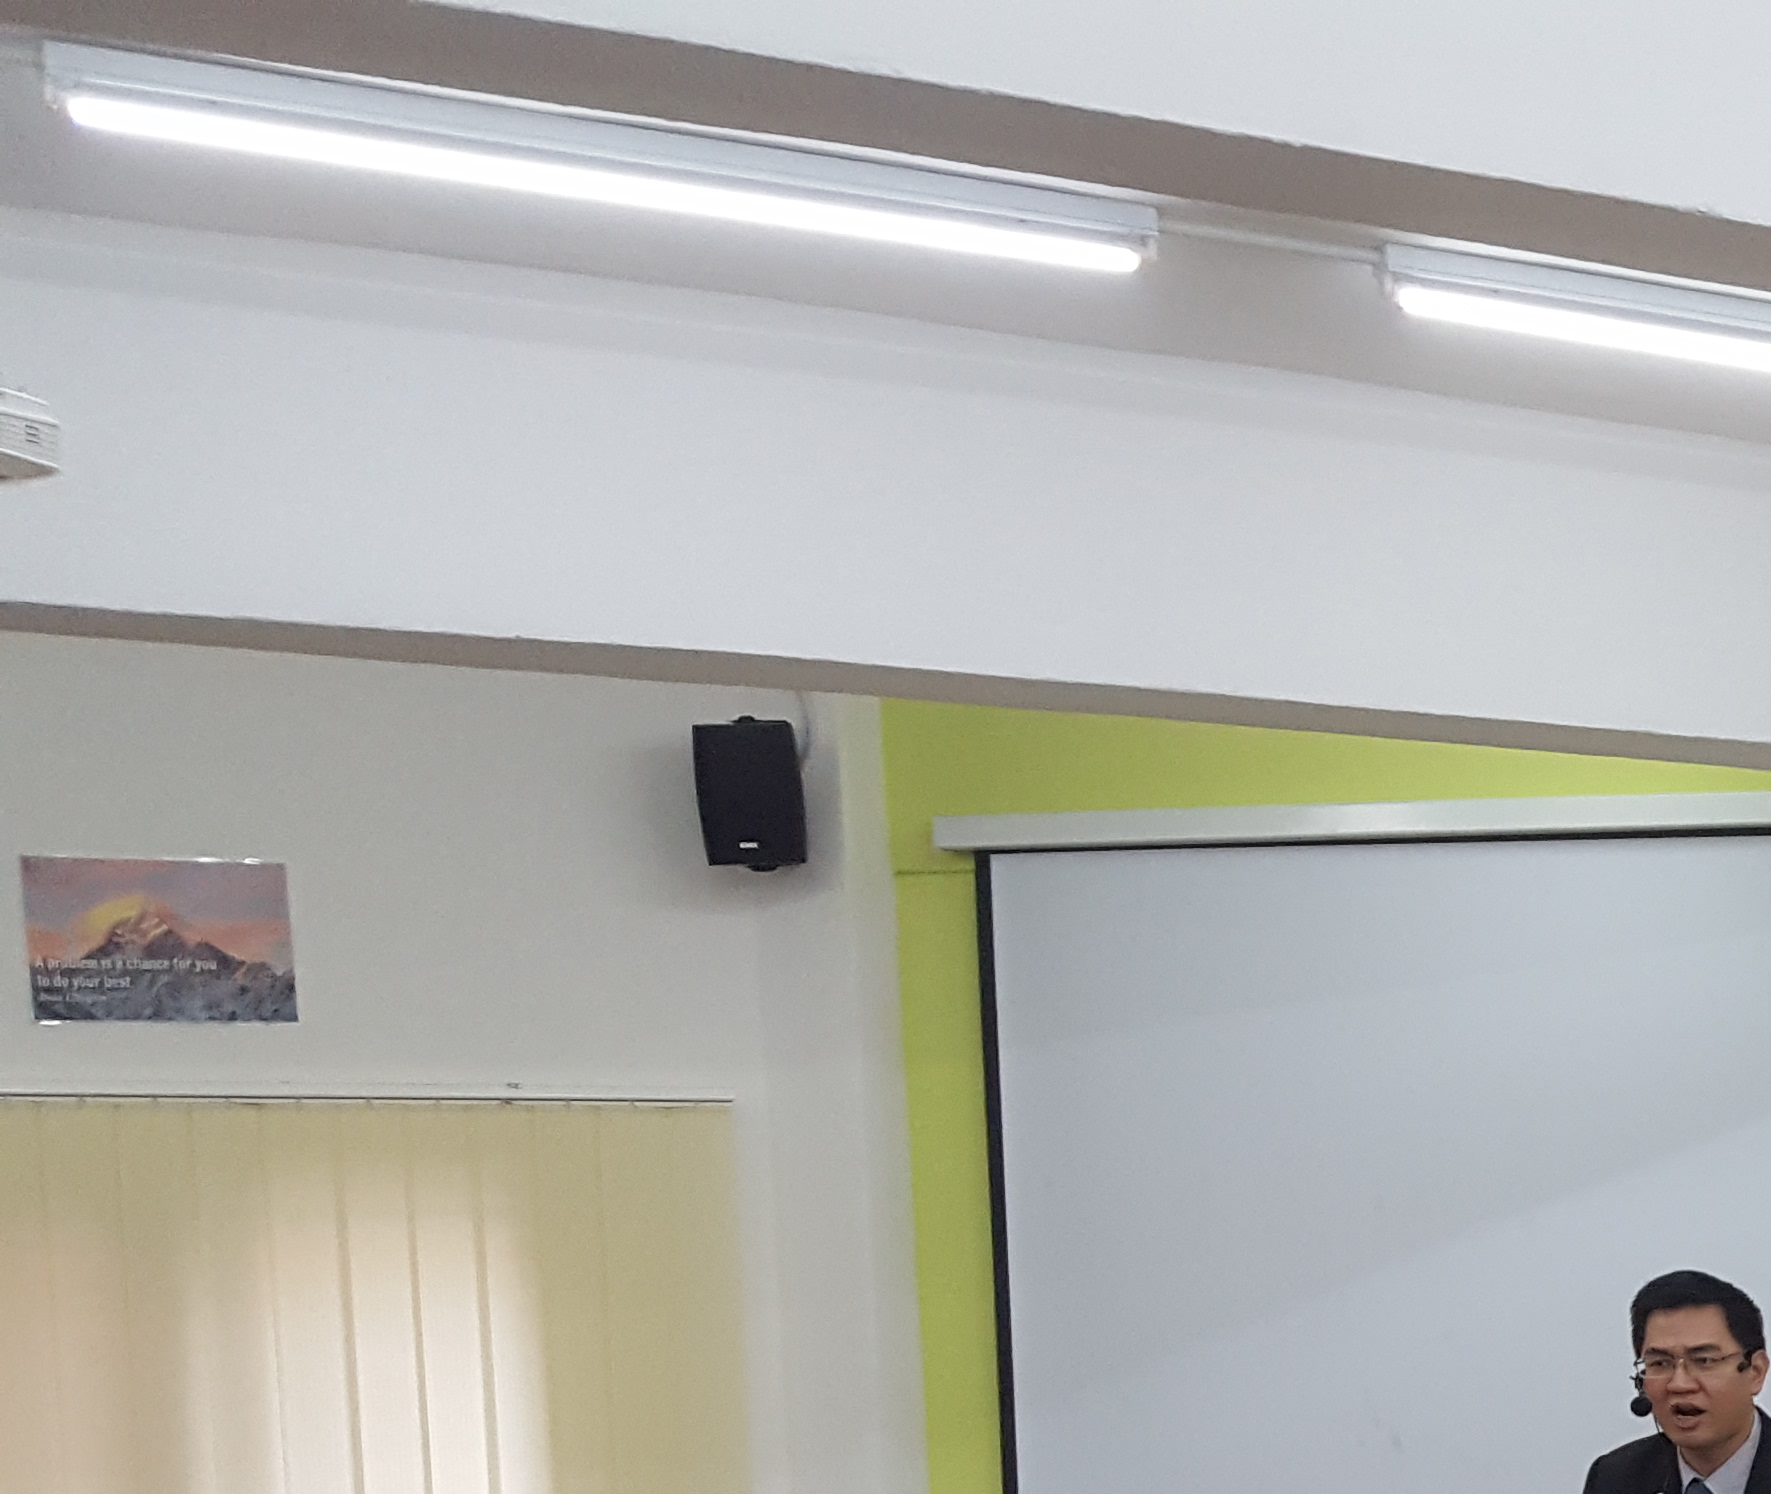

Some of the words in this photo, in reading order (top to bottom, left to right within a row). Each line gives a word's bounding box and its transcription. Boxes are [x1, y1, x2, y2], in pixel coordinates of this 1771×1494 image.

[126, 958, 170, 970] chance
[172, 956, 191, 970] for
[195, 960, 217, 973] you
[53, 972, 69, 988] do
[71, 978, 101, 991] your
[103, 976, 132, 989] best
